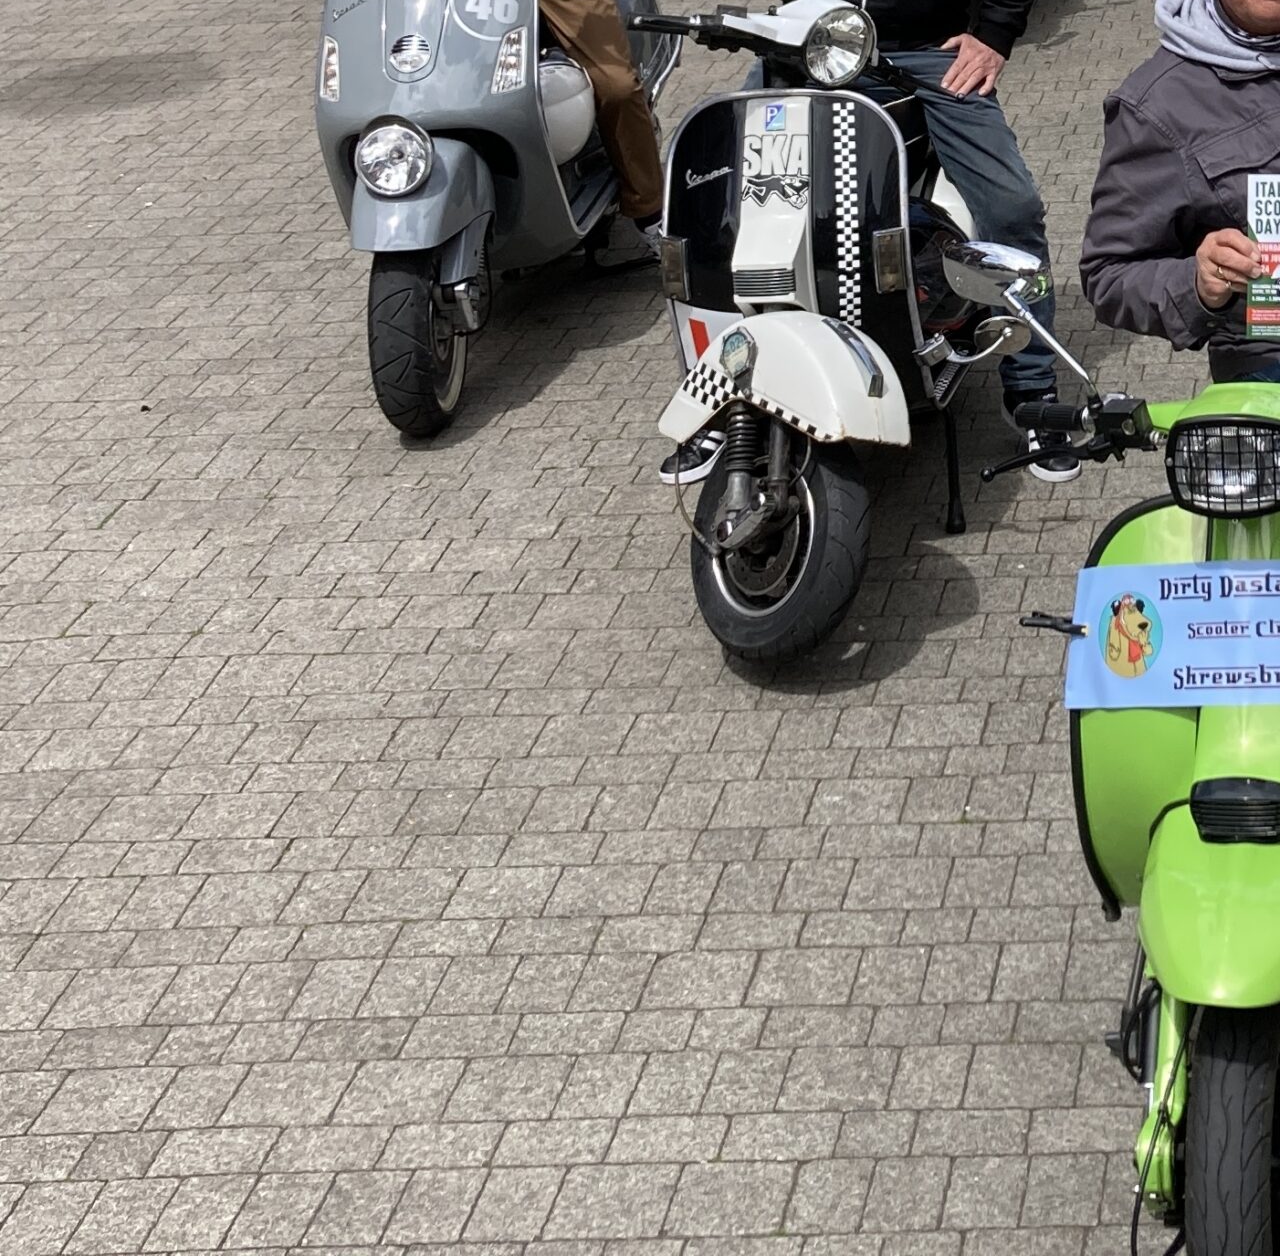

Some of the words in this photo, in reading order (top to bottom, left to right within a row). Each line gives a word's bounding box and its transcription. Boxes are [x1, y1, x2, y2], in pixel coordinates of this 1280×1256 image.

[742, 134, 810, 177] SKA
[685, 166, 734, 190] Vespa
[1159, 574, 1213, 602] Dirty
[1187, 621, 1251, 640] Scooter
